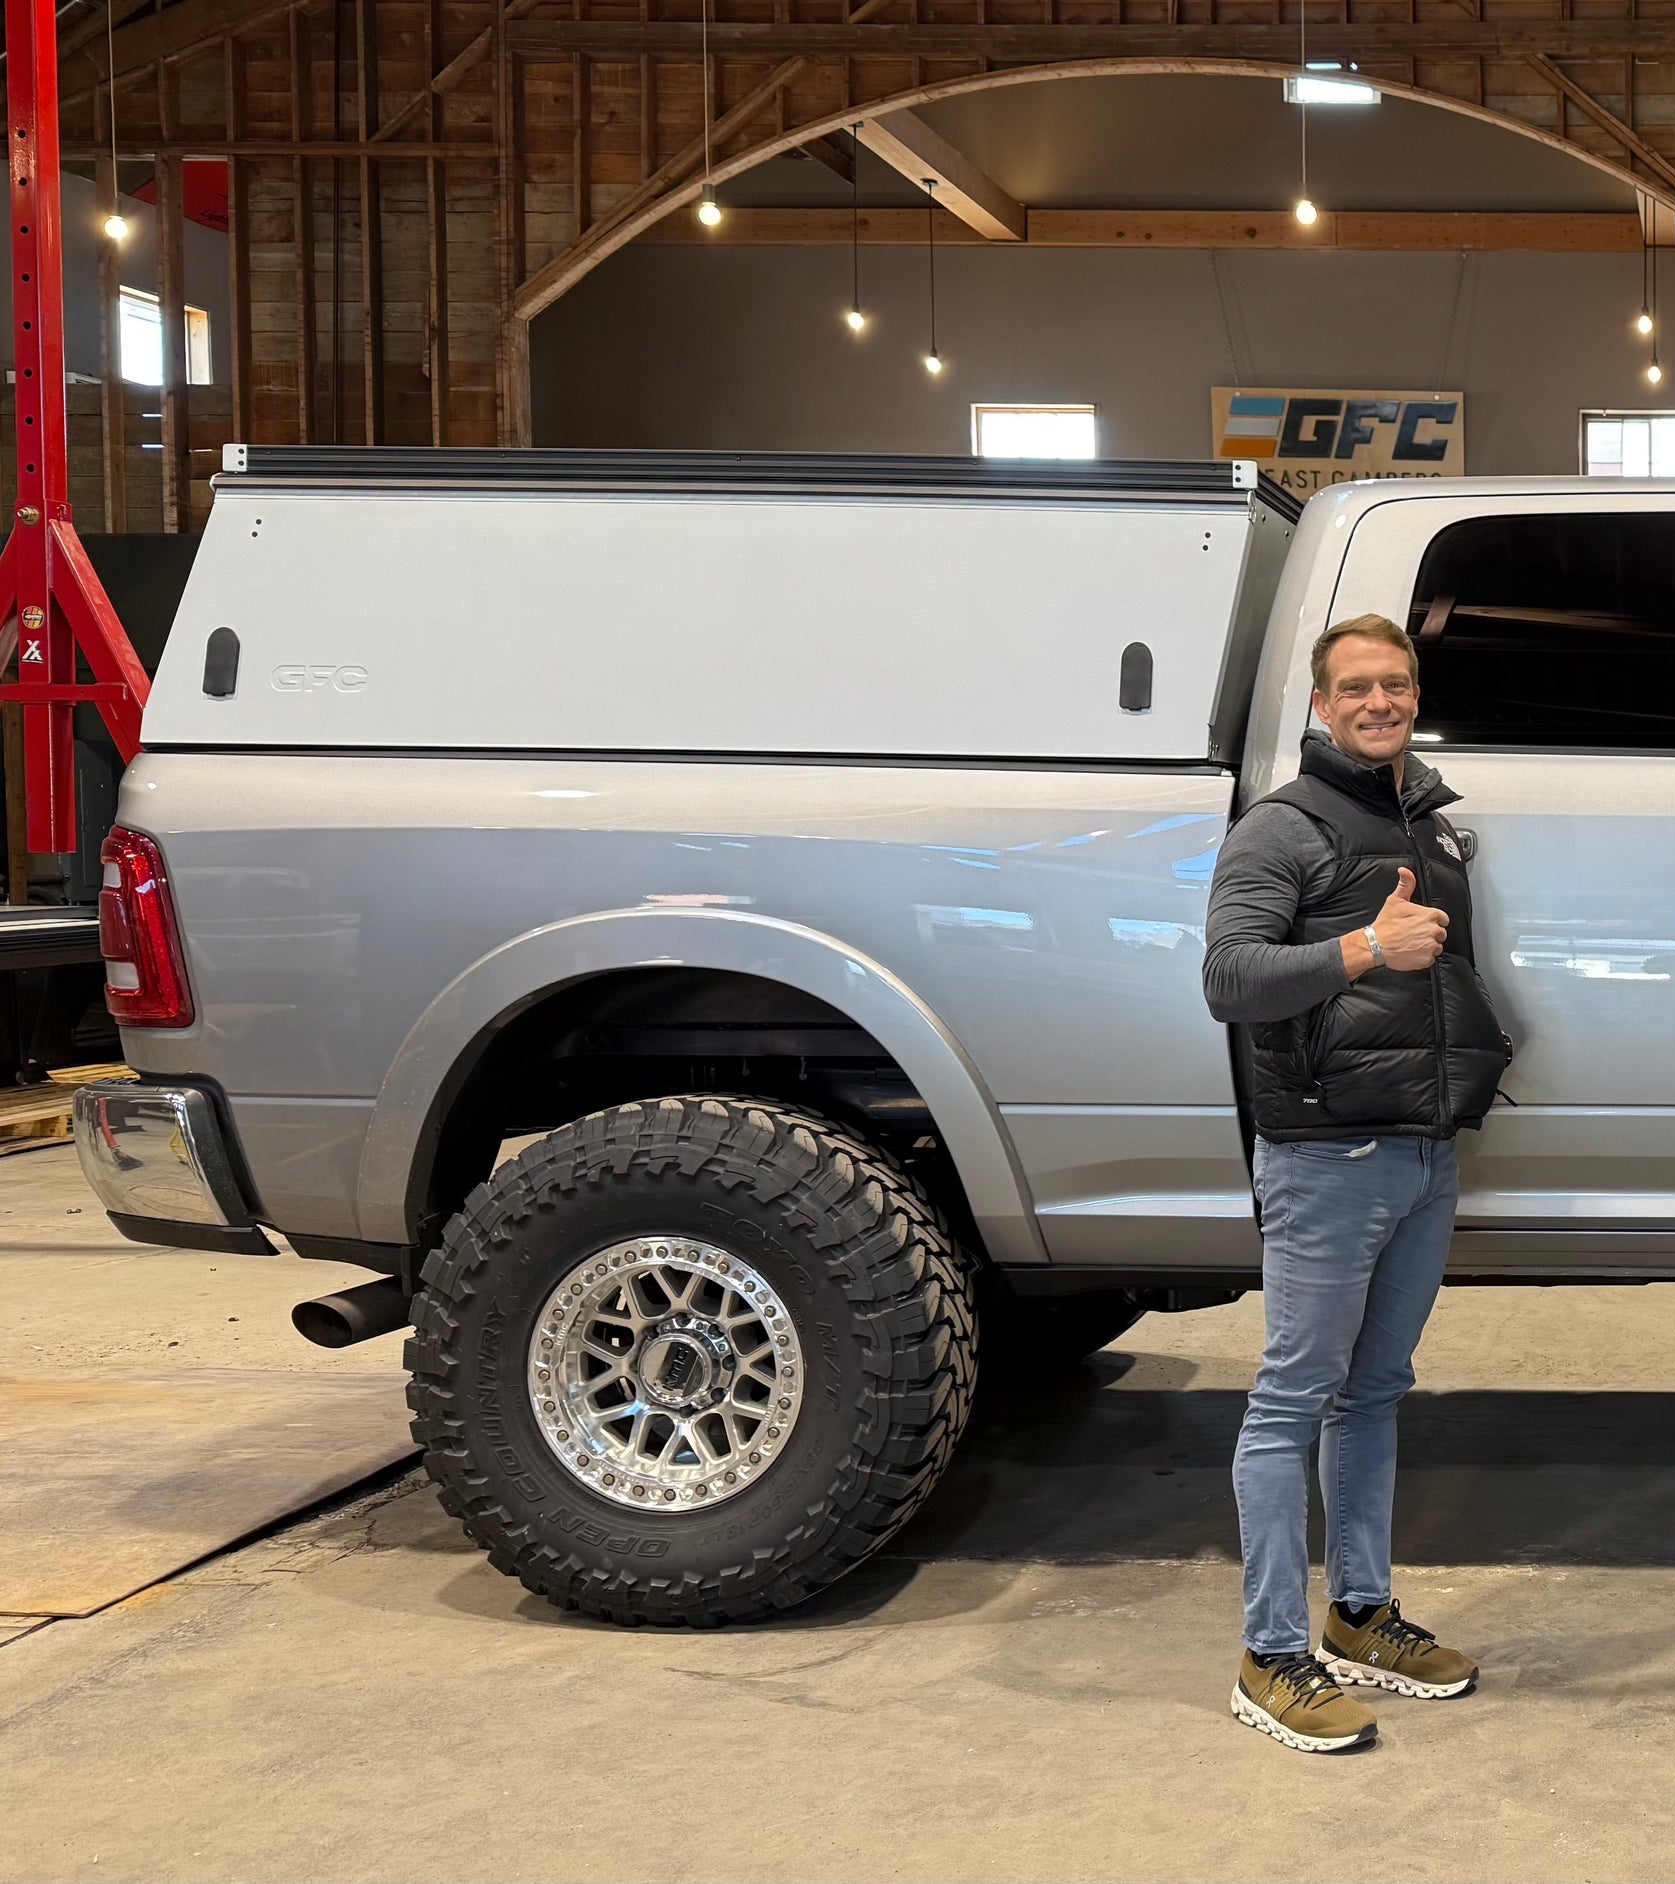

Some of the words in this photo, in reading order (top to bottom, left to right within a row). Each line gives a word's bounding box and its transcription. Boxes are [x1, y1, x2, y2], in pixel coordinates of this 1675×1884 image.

[1278, 398, 1458, 461] GFC
[270, 664, 368, 693] GFC
[476, 1298, 546, 1504] COUNTRY
[550, 1506, 672, 1559] OPEN
